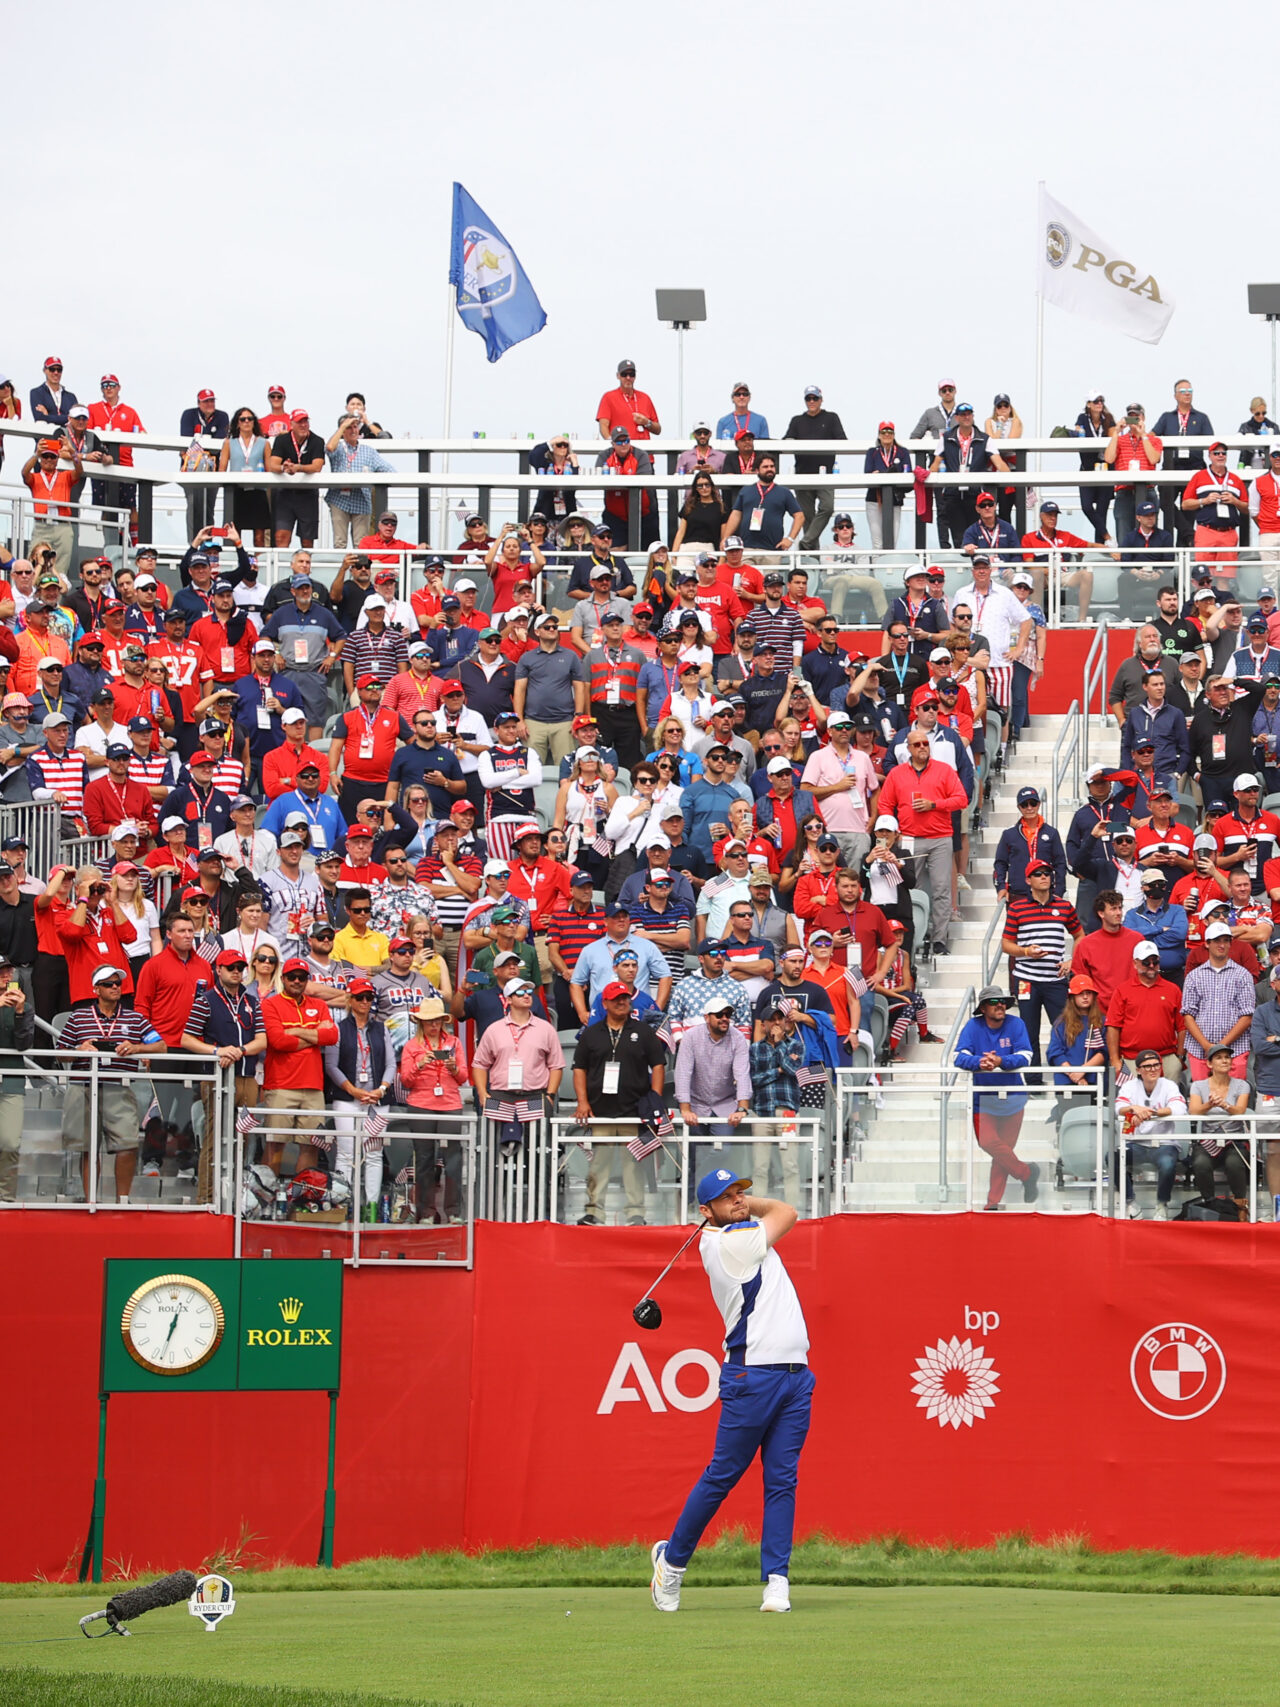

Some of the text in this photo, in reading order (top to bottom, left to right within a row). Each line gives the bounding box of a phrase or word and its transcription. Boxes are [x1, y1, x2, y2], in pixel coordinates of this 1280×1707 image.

[1072, 243, 1163, 304] PGA
[388, 986, 424, 1006] USA
[964, 1305, 1000, 1336] bp
[247, 1329, 332, 1345] ROLEX
[1143, 1328, 1212, 1354] BMW
[597, 1342, 722, 1414] AO
[217, 1604, 232, 1612] CUP
